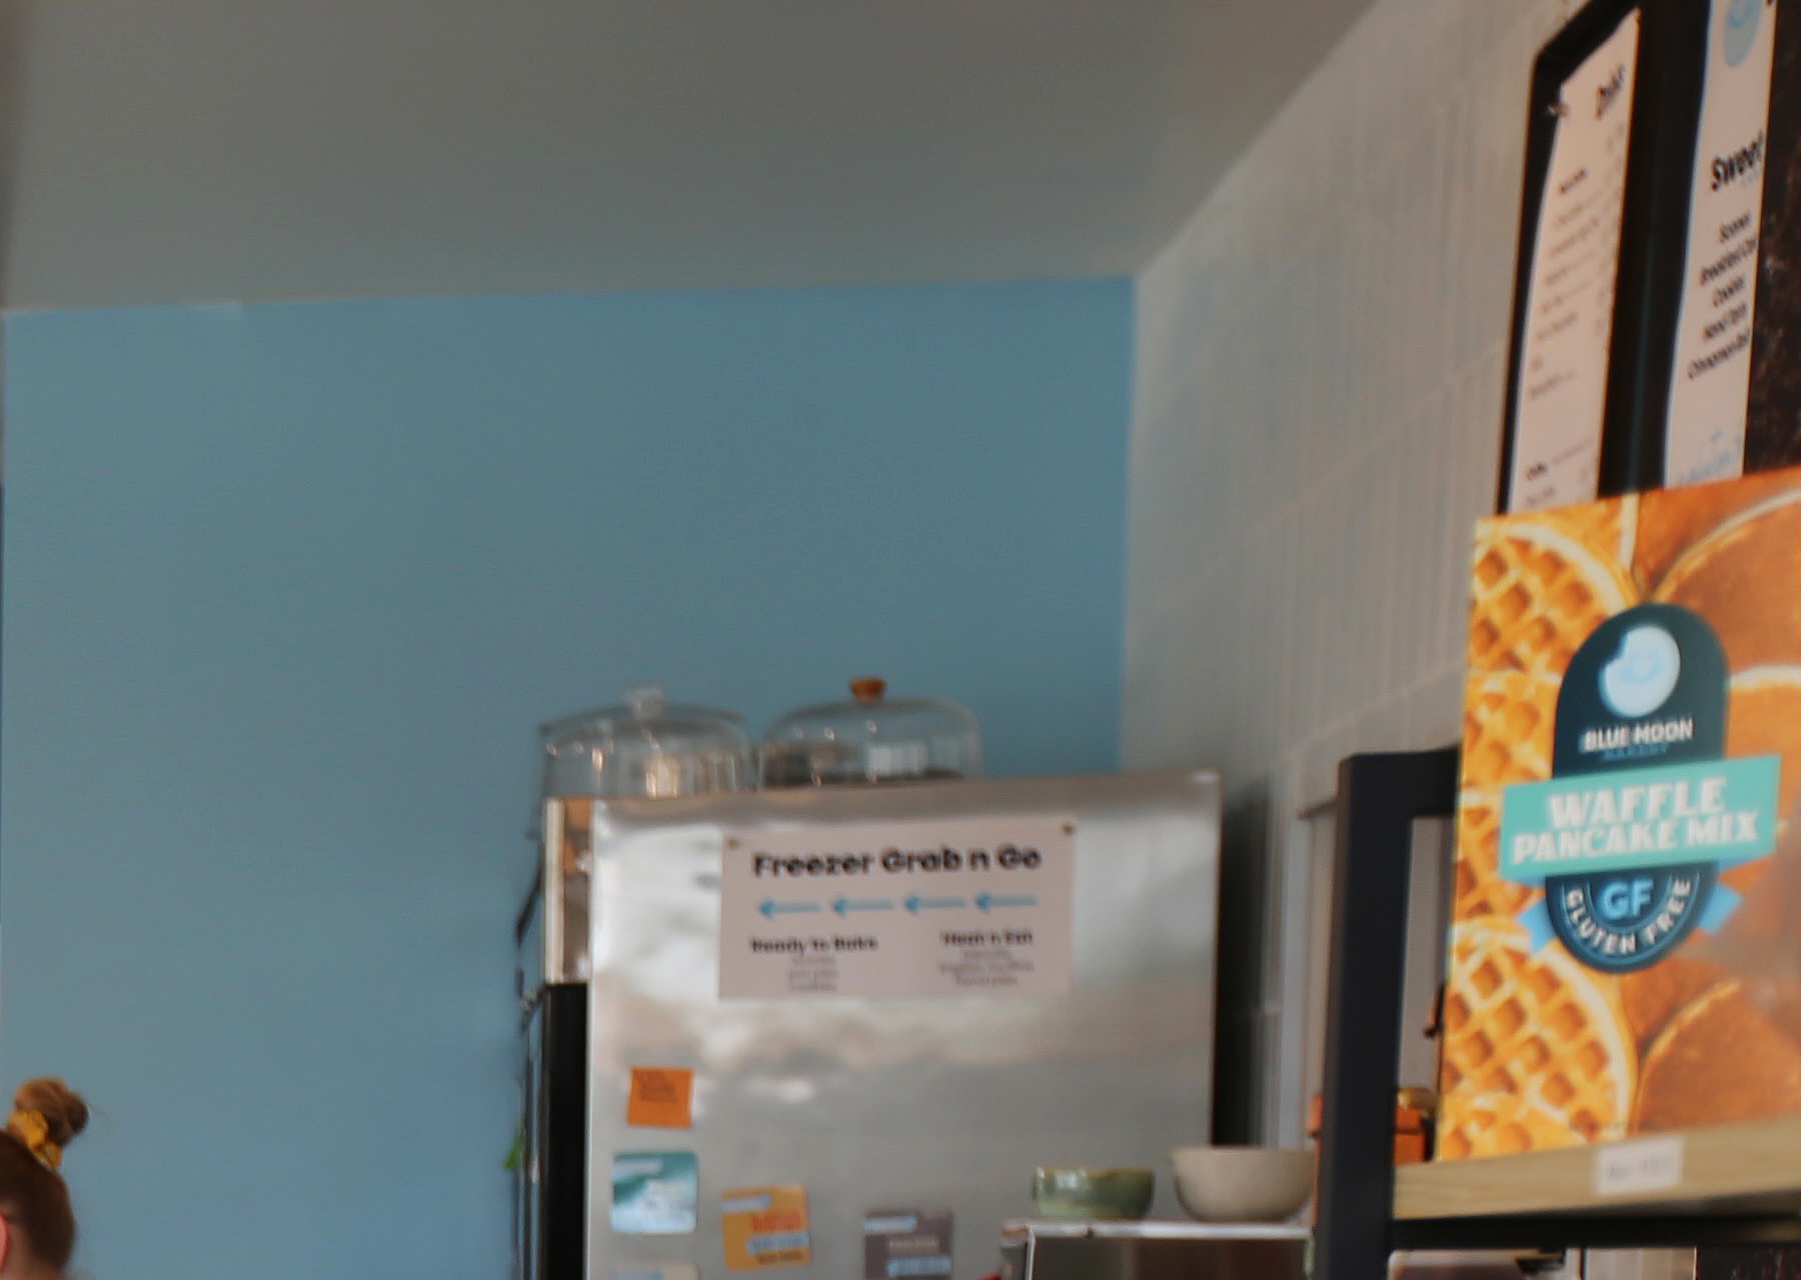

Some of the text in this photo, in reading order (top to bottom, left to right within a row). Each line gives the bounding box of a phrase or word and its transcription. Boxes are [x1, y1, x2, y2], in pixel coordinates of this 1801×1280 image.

[1582, 717, 1695, 752] BLUE MOON
[1550, 776, 1728, 830] WAFFLE
[753, 844, 1043, 877] Freezer Grab n Go
[1511, 810, 1760, 866] PANCAKE MIX
[1567, 878, 1692, 955] GLUTEN FREE
[1601, 878, 1654, 921] GF
